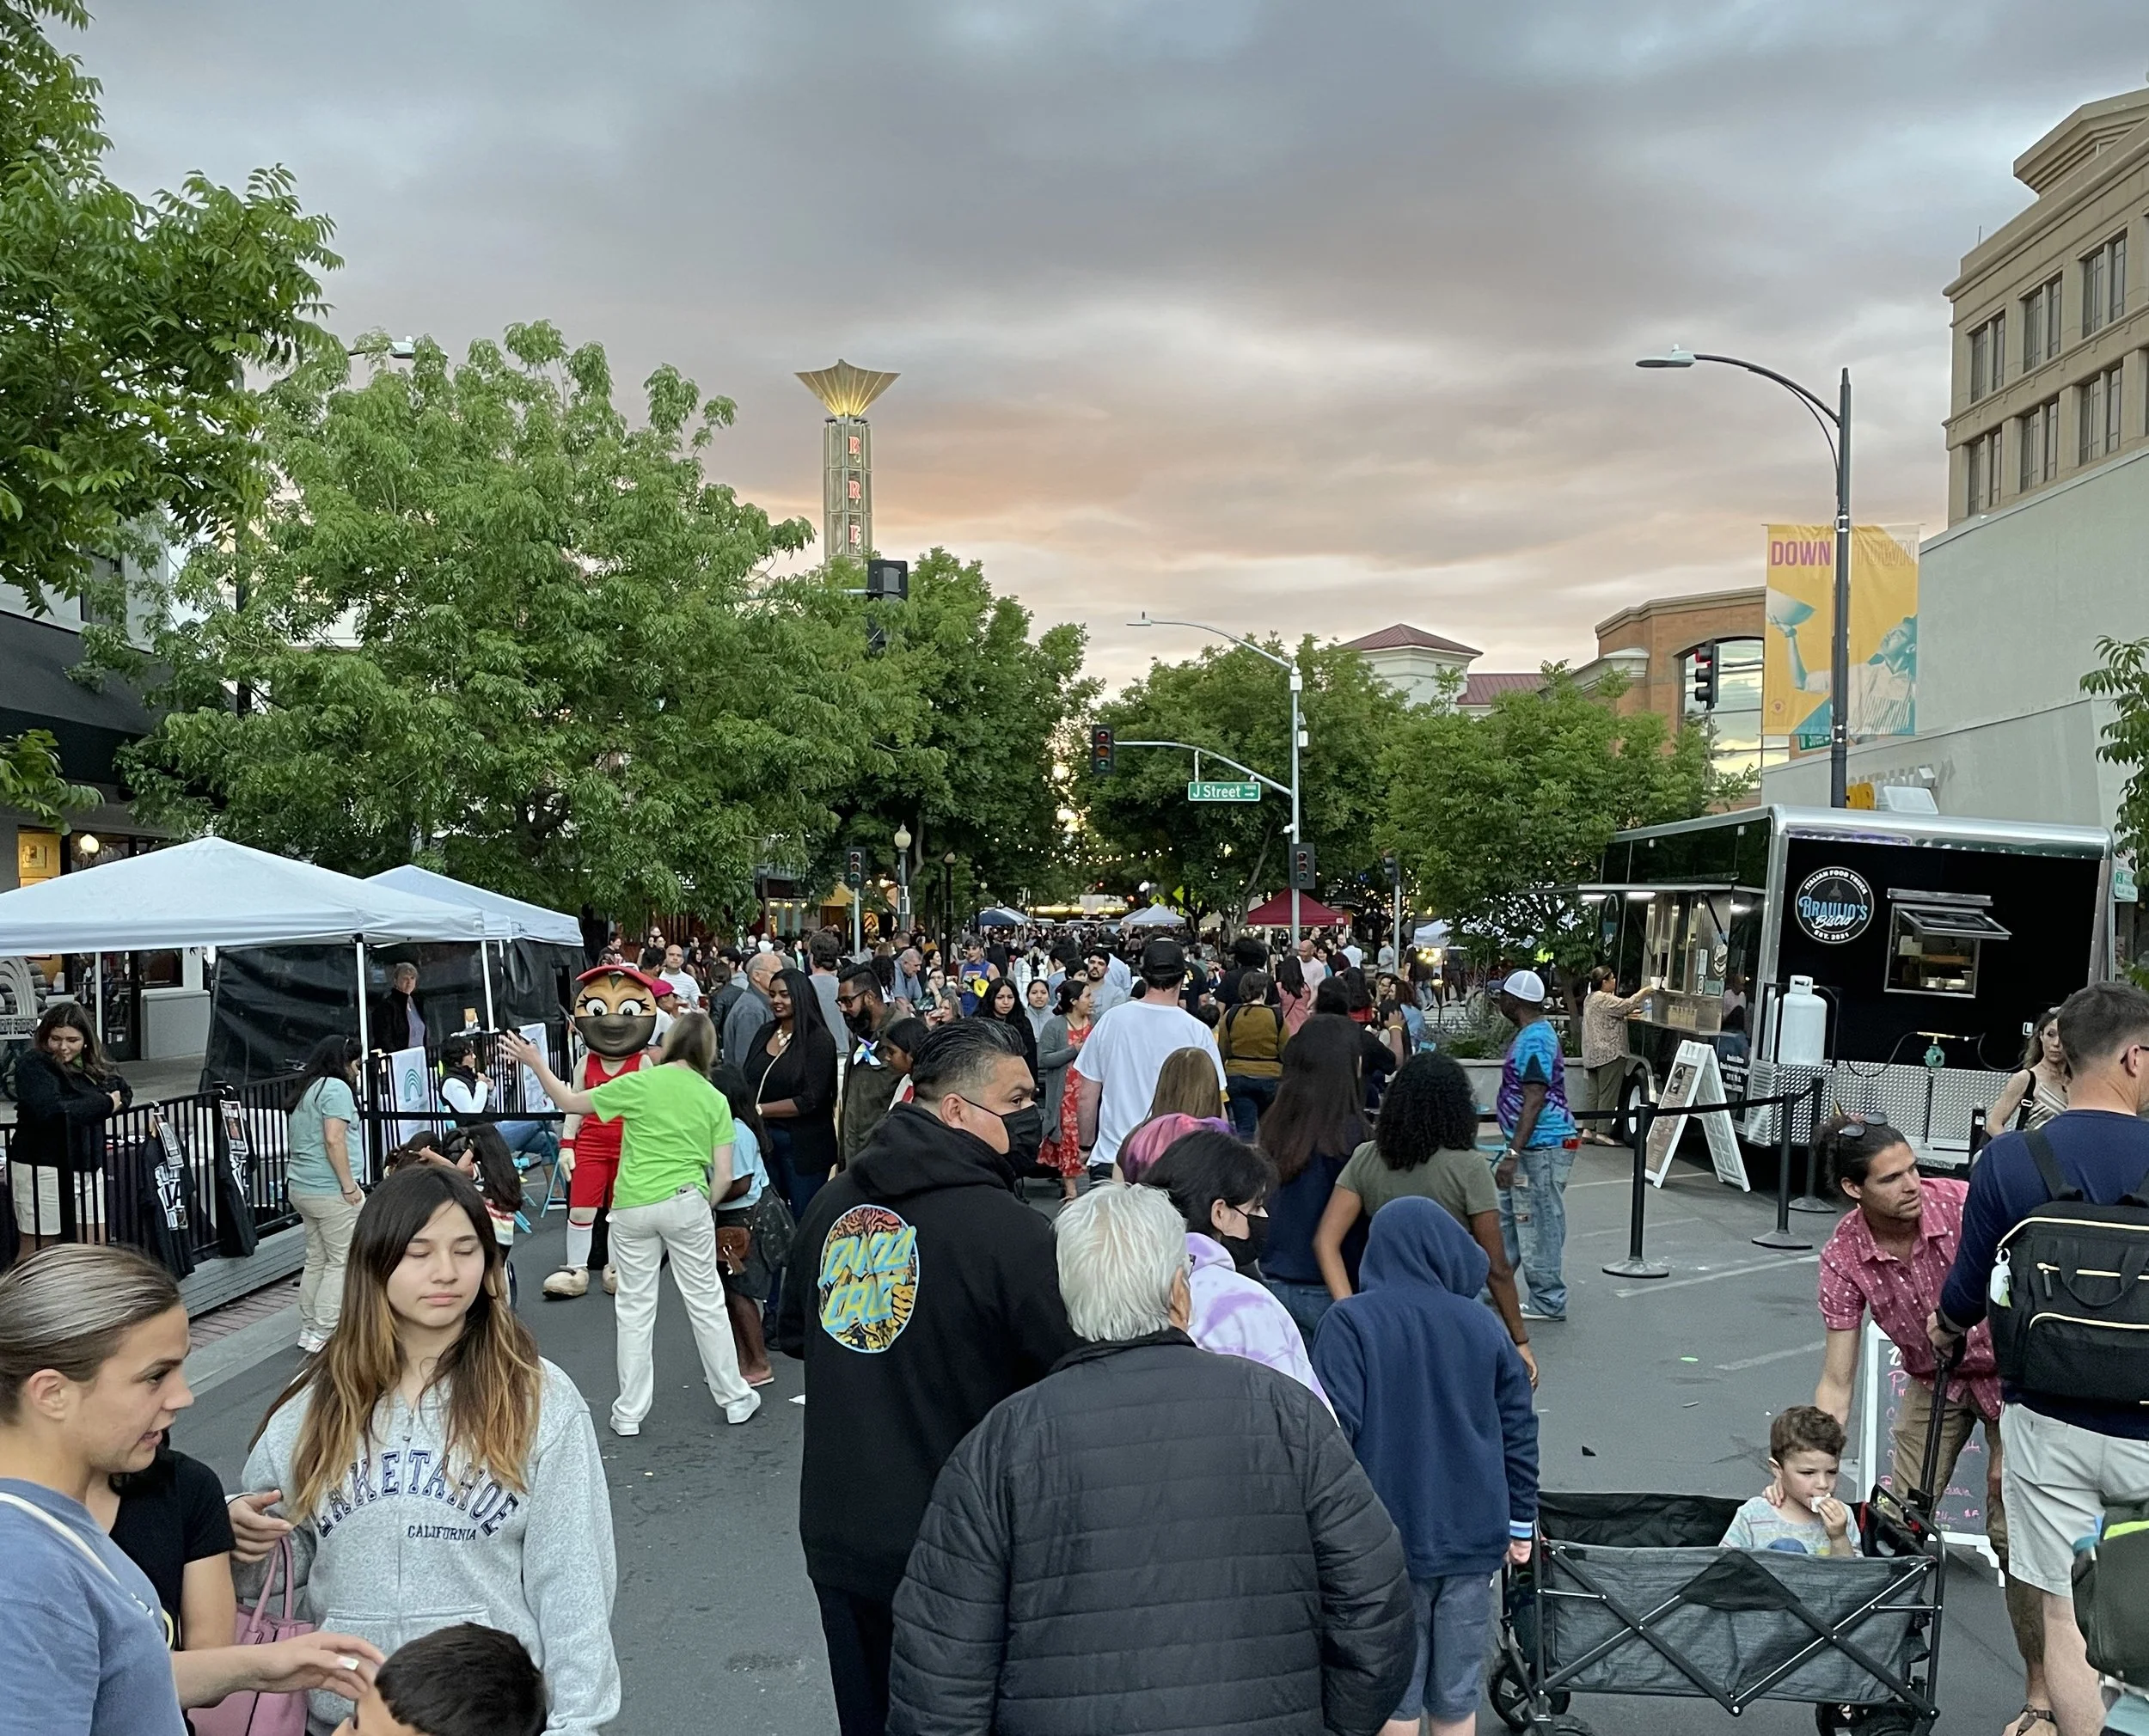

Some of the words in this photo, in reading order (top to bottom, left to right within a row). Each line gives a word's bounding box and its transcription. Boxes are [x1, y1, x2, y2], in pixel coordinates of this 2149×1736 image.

[1771, 541, 1831, 566] DOWN
[1192, 785, 1200, 798] J
[1203, 785, 1240, 798] Street
[1804, 871, 1828, 890] ITALIAN
[1849, 874, 1868, 895] TRUCK
[407, 1525, 477, 1541] CALIFORNIA
